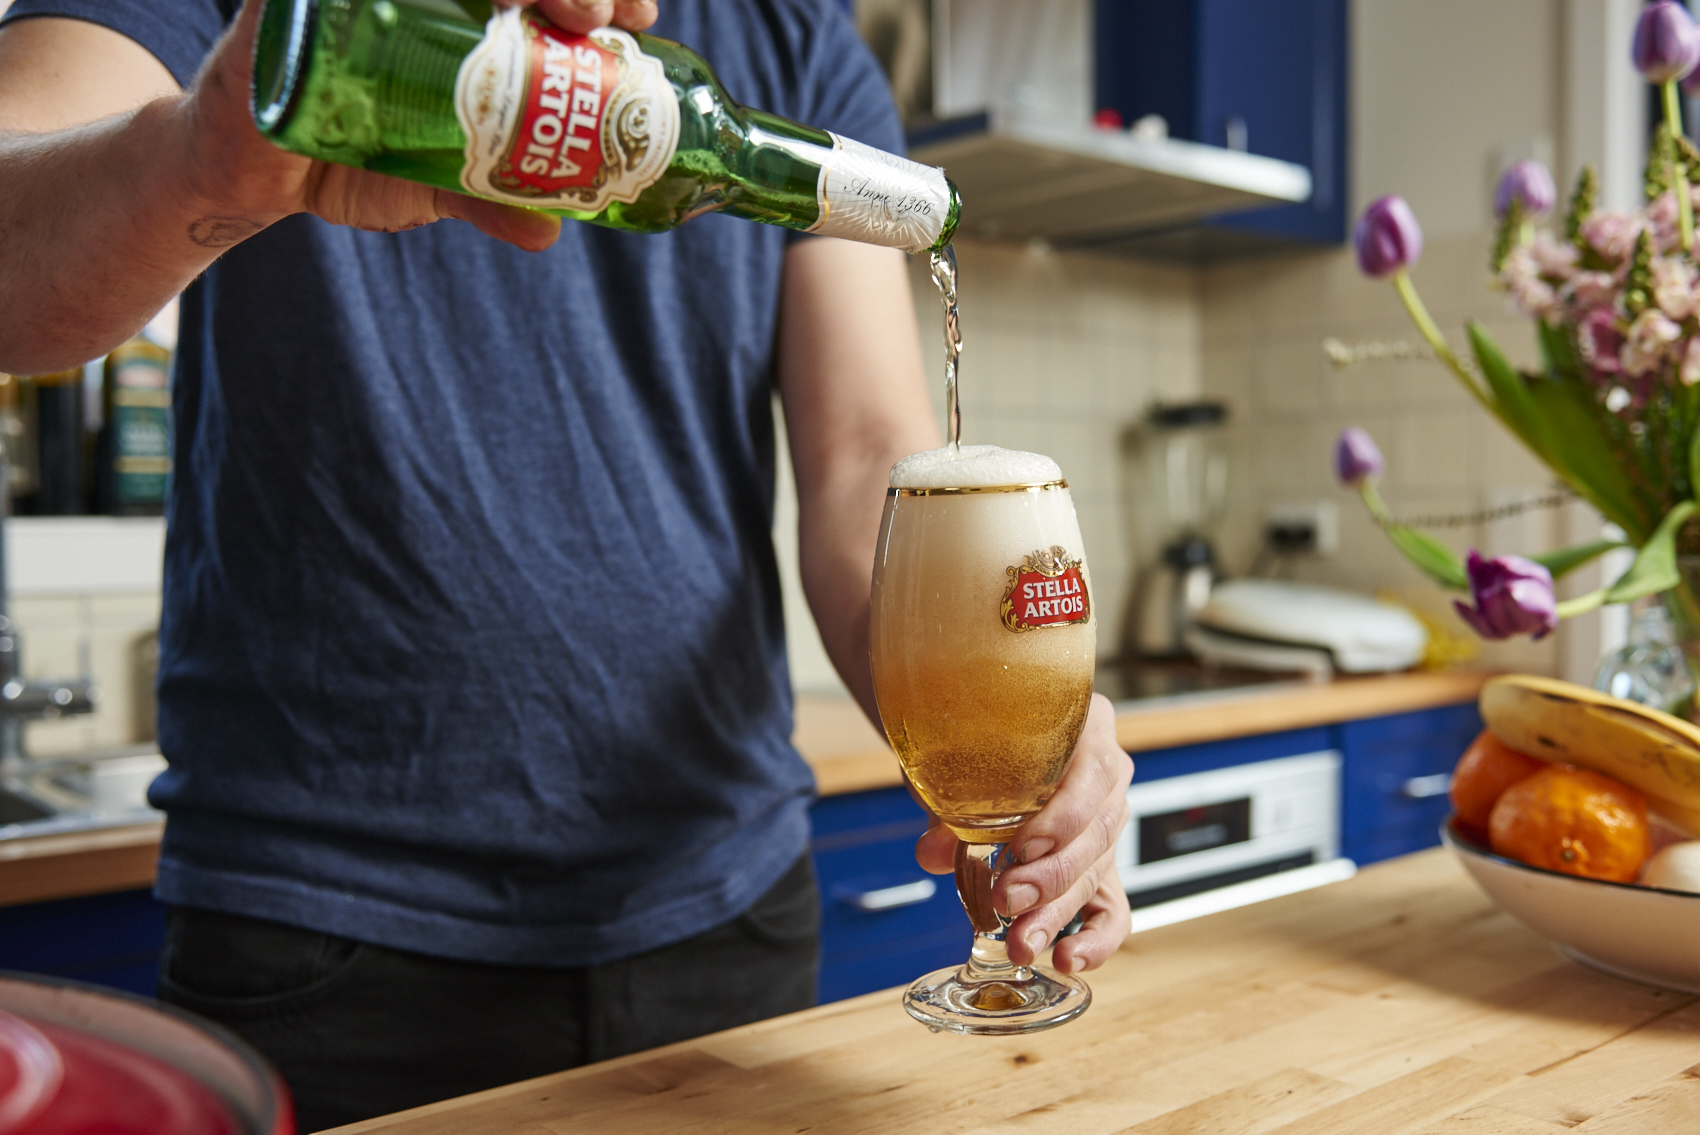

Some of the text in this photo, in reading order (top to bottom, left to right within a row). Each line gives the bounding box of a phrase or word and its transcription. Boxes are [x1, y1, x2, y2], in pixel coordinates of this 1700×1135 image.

[520, 35, 572, 176] ARTOIS
[551, 45, 603, 178] STELLA
[844, 177, 935, 216] Anno 1366
[1022, 577, 1082, 600] STELLA
[1024, 595, 1084, 619] ARTOIS
